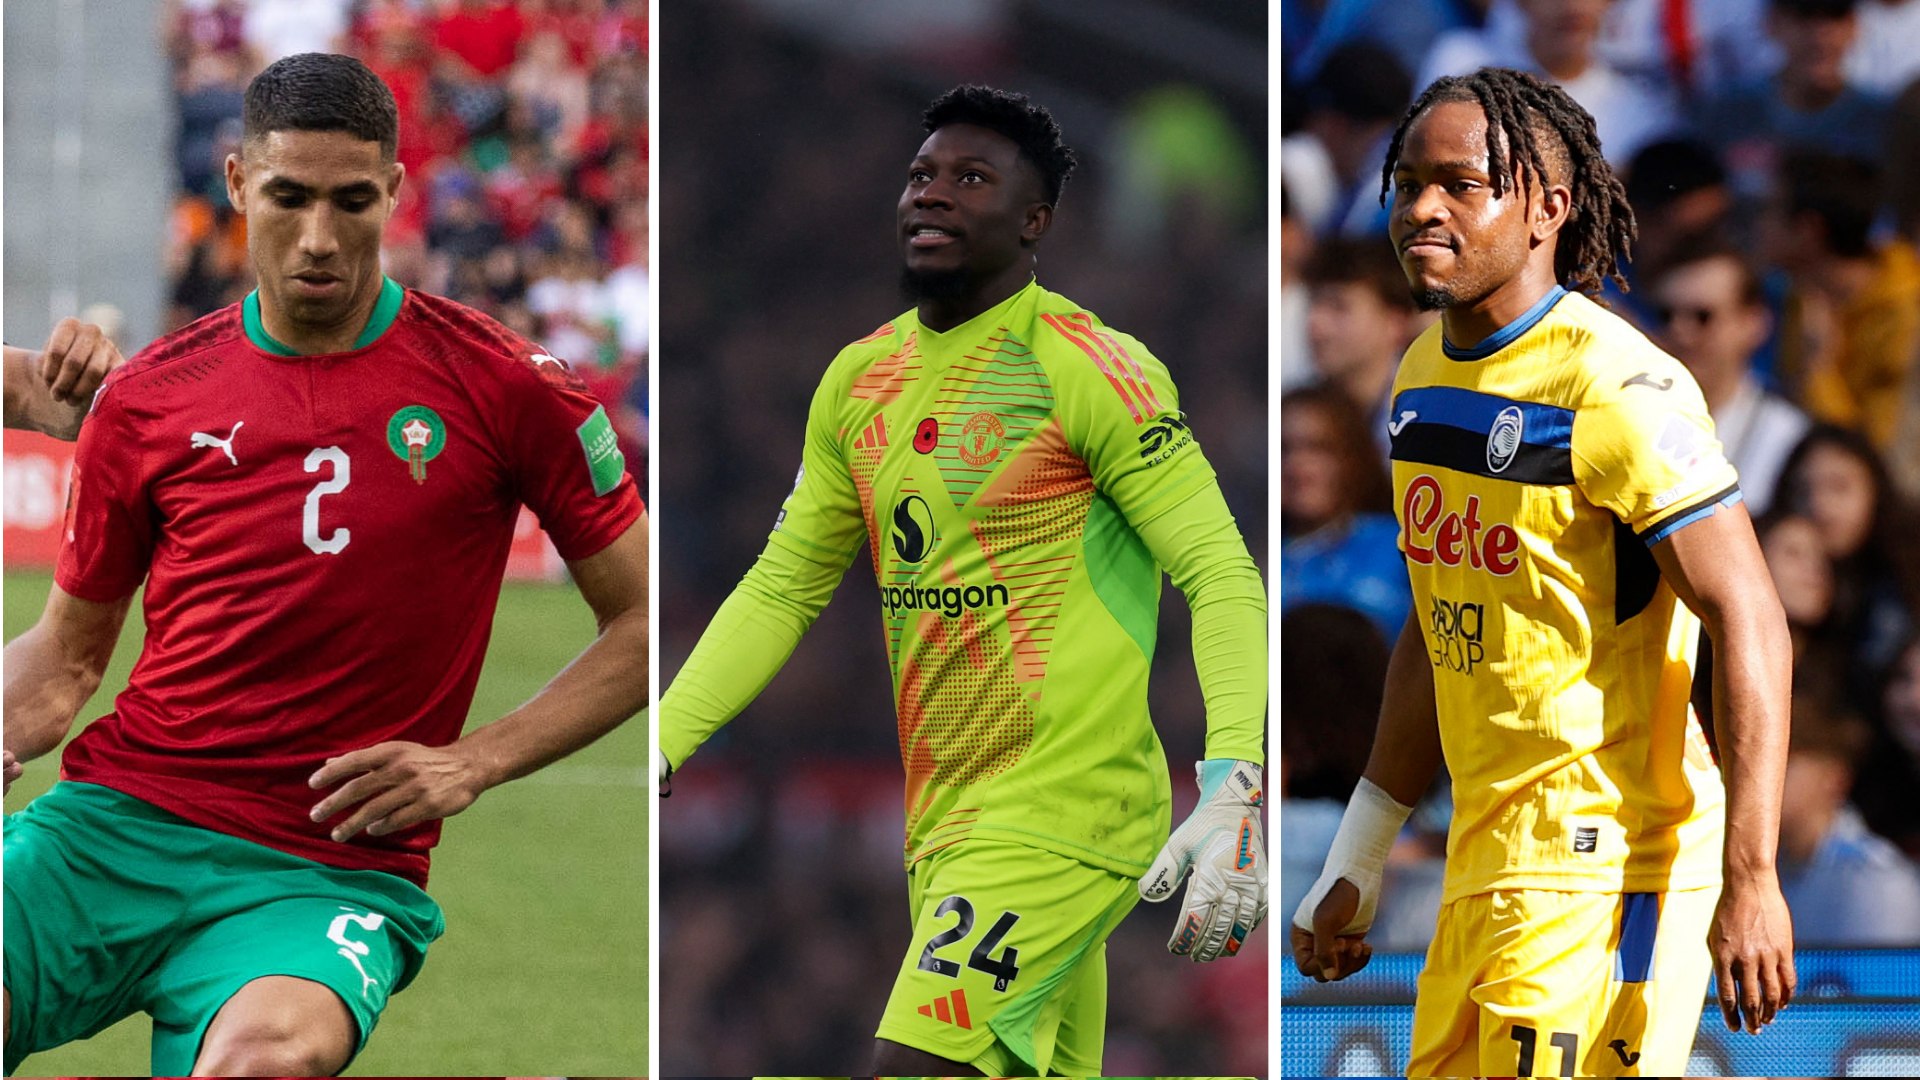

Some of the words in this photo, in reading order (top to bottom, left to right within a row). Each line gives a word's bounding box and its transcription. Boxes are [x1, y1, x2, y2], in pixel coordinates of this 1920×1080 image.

[963, 453, 992, 465] UNITED
[966, 413, 1003, 434] MANCHESTER
[303, 445, 351, 555] 2
[1403, 474, 1520, 577] Lete
[917, 895, 1020, 993] 24
[1511, 1025, 1578, 1077] 11
